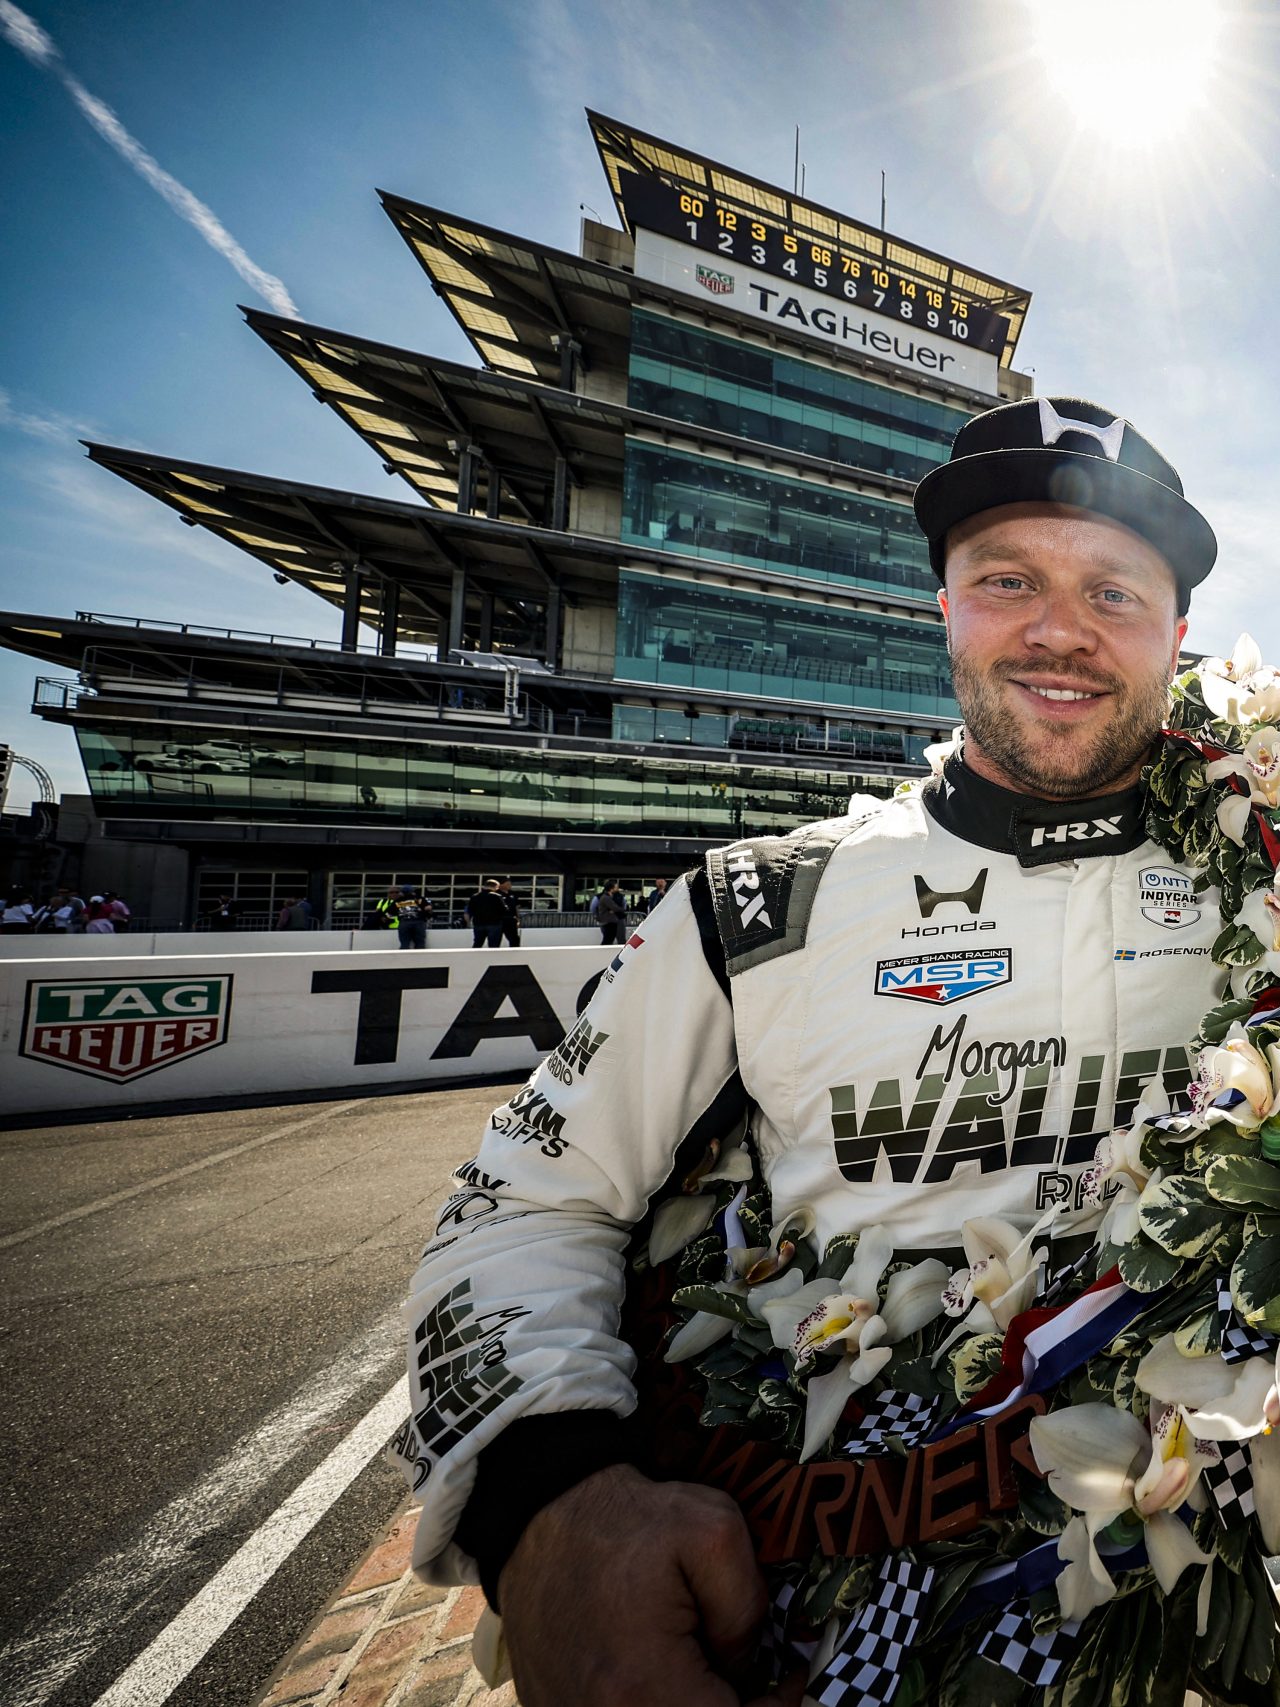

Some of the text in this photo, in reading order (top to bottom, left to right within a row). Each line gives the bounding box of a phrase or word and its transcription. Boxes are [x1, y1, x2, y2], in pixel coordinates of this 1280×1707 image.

[680, 195, 968, 319] 60 12 3 5 66 76 10 14 18 75
[686, 221, 969, 339] 1 2 3 4 5 6 7 8 9 10
[702, 269, 730, 284] TAG
[1030, 814, 1124, 848] HRX
[727, 850, 772, 931] HRX
[1141, 891, 1197, 904] INDYCAR
[1162, 877, 1188, 888] NTT
[901, 920, 996, 939] Honda
[879, 949, 1009, 969] MEYER SHANK RACING
[1139, 948, 1212, 959] ROSENQV
[881, 961, 1005, 988] MSR
[50, 983, 209, 1018] TAG
[311, 964, 610, 1067] TA
[41, 1021, 212, 1071] HEUER
[915, 1013, 1067, 1107] Morgan
